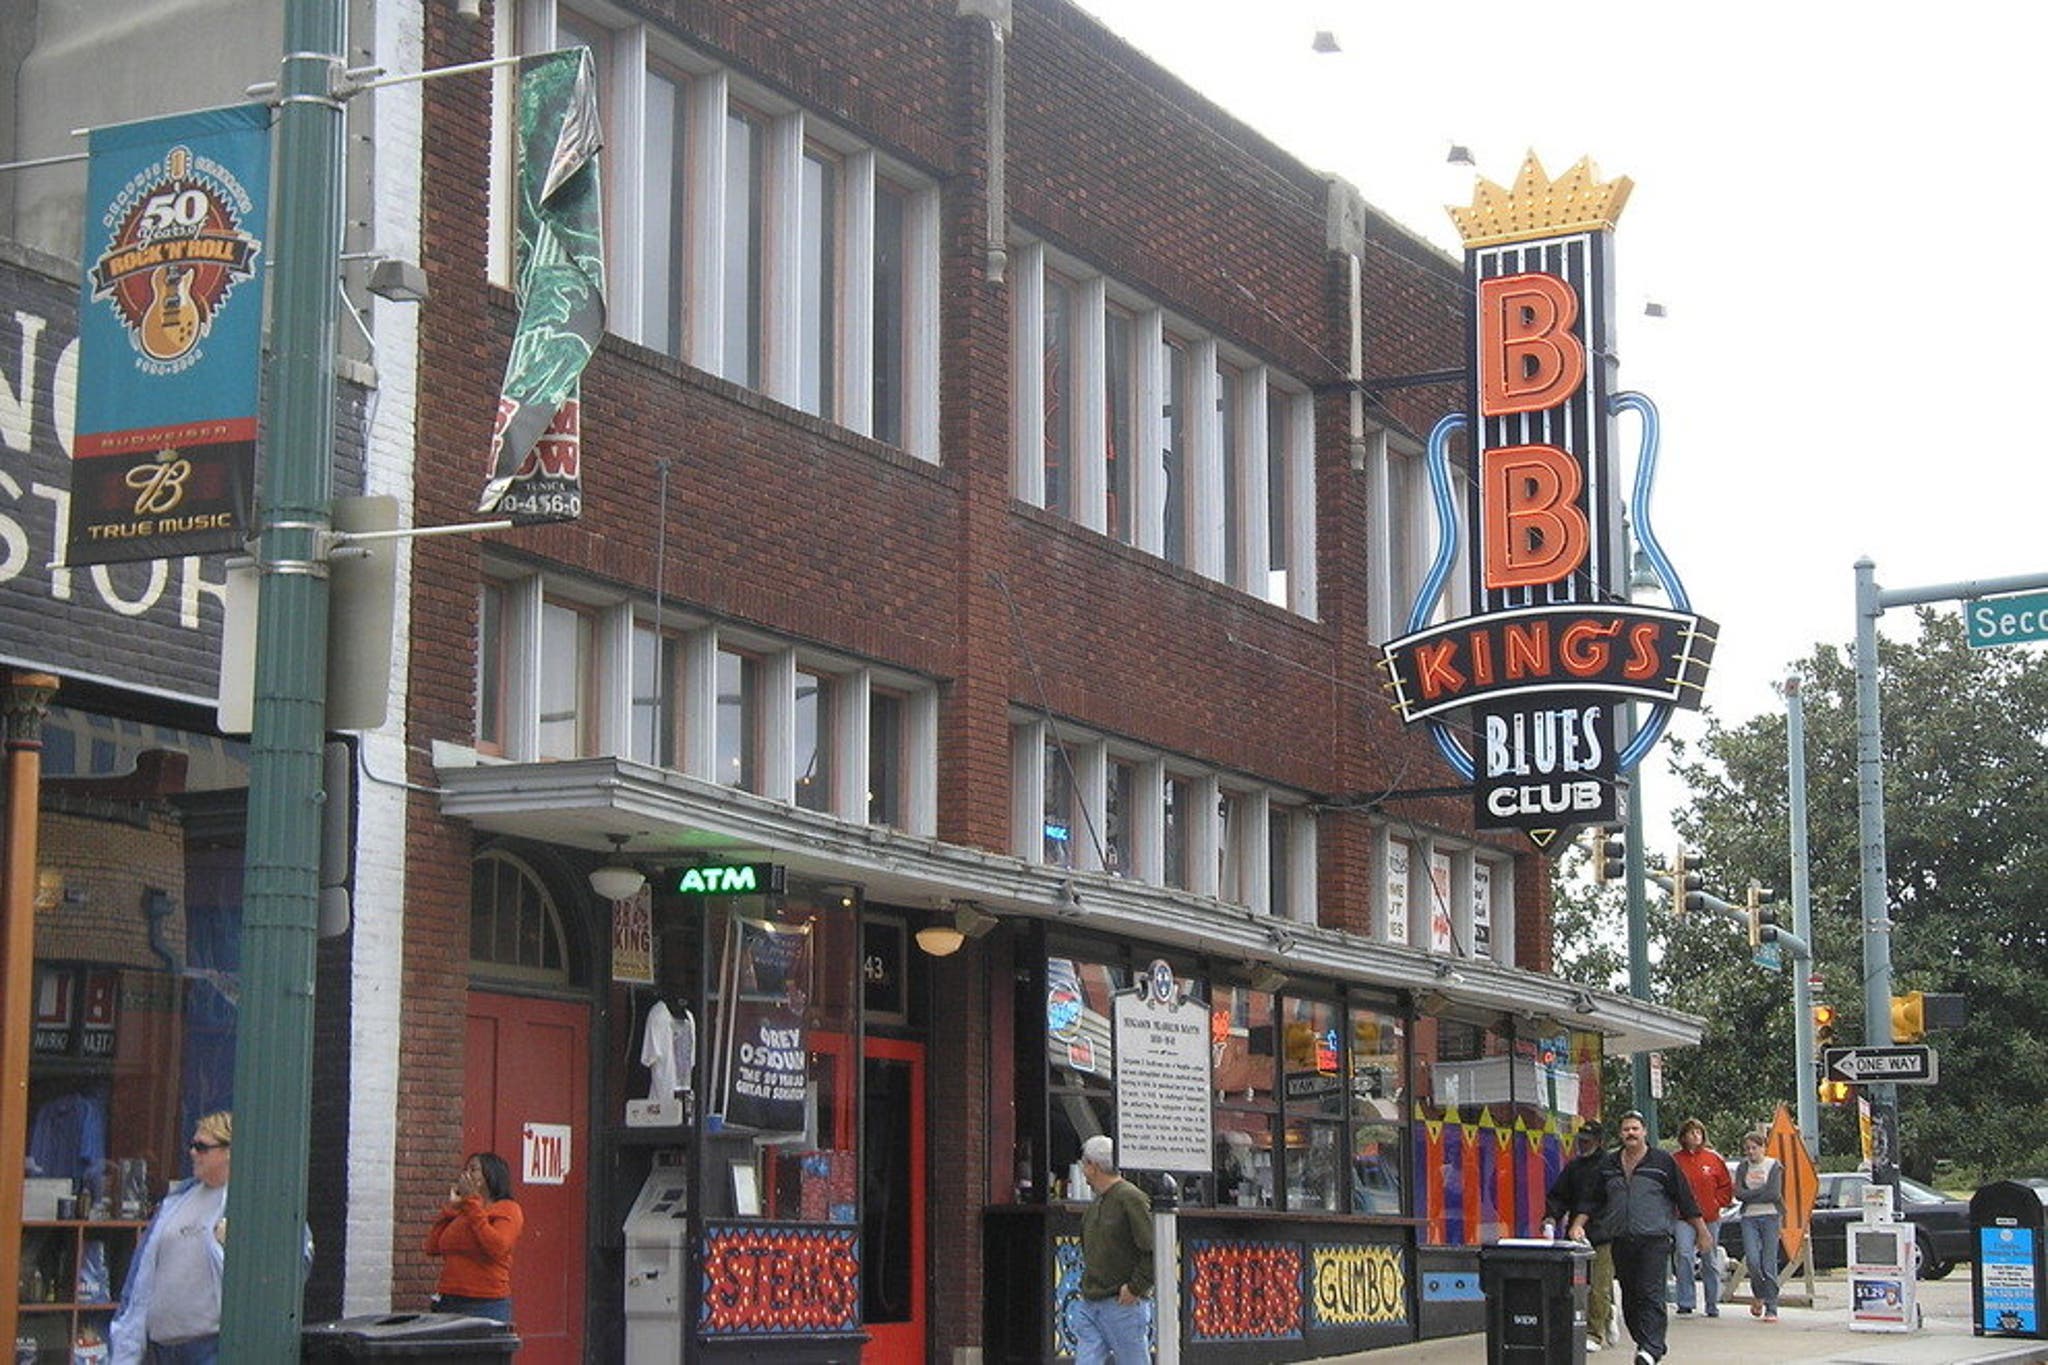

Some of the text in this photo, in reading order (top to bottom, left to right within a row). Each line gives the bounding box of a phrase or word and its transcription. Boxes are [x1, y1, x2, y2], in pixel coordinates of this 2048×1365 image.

[141, 190, 209, 229] 50
[109, 245, 163, 277] ROCK
[187, 240, 235, 261] ROLL
[1479, 272, 1586, 417] B
[101, 425, 227, 448] BUDWEISER
[88, 512, 233, 540] TRUE MUSIC
[1482, 445, 1590, 590] B
[1415, 619, 1661, 701] KING'S
[1486, 707, 1602, 779] BLUES
[1487, 781, 1602, 817] CLUB
[680, 866, 757, 892] ATM
[1856, 1055, 1917, 1071] ONE WAY
[531, 1134, 562, 1178] ATM
[719, 1247, 847, 1314] STEAKS
[1318, 1257, 1398, 1316] GUMBO
